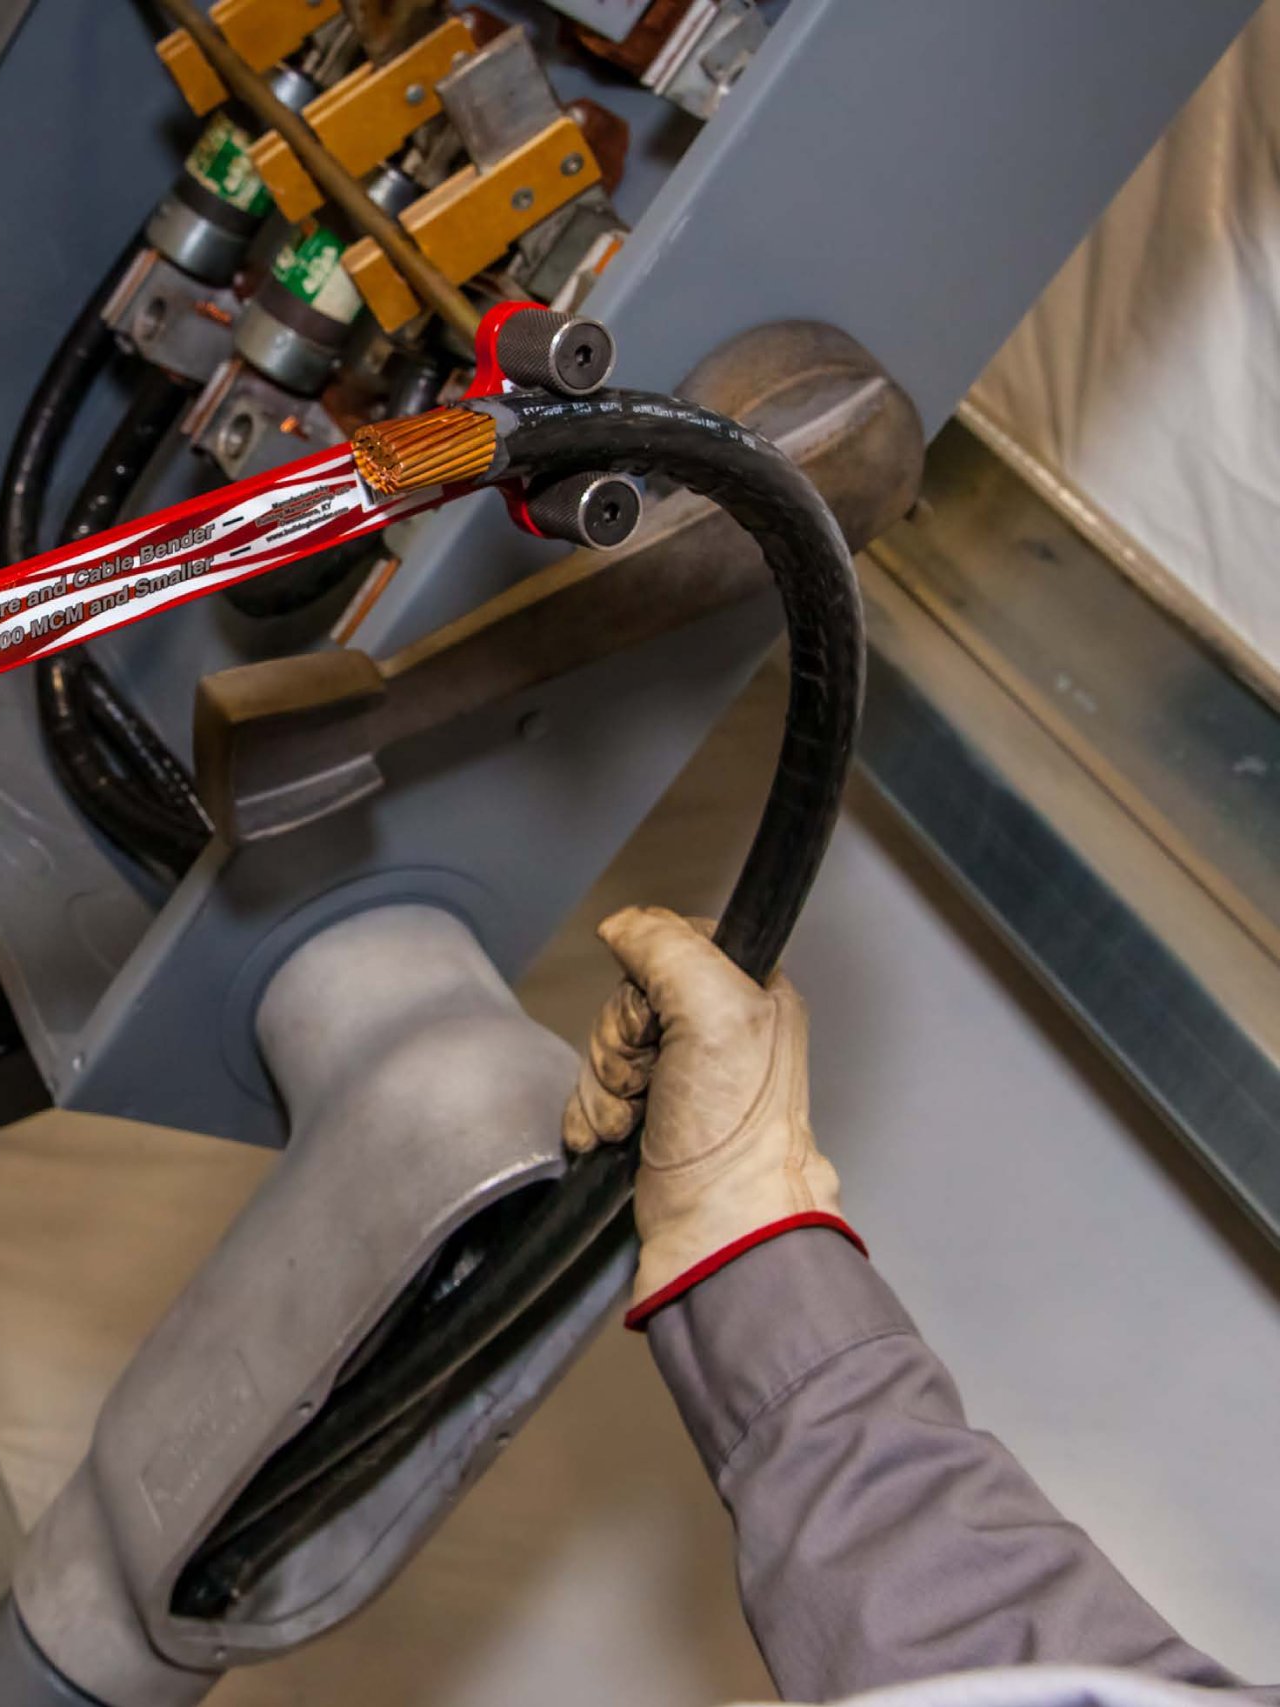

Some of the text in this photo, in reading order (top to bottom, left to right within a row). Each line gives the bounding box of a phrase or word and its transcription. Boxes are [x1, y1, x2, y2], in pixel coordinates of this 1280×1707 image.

[321, 499, 332, 512] KY
[27, 576, 67, 607] and
[72, 555, 135, 589] Cable
[139, 523, 216, 566] Bender
[30, 600, 84, 638] MCM
[89, 585, 130, 616] and
[134, 556, 215, 598] Smaller
